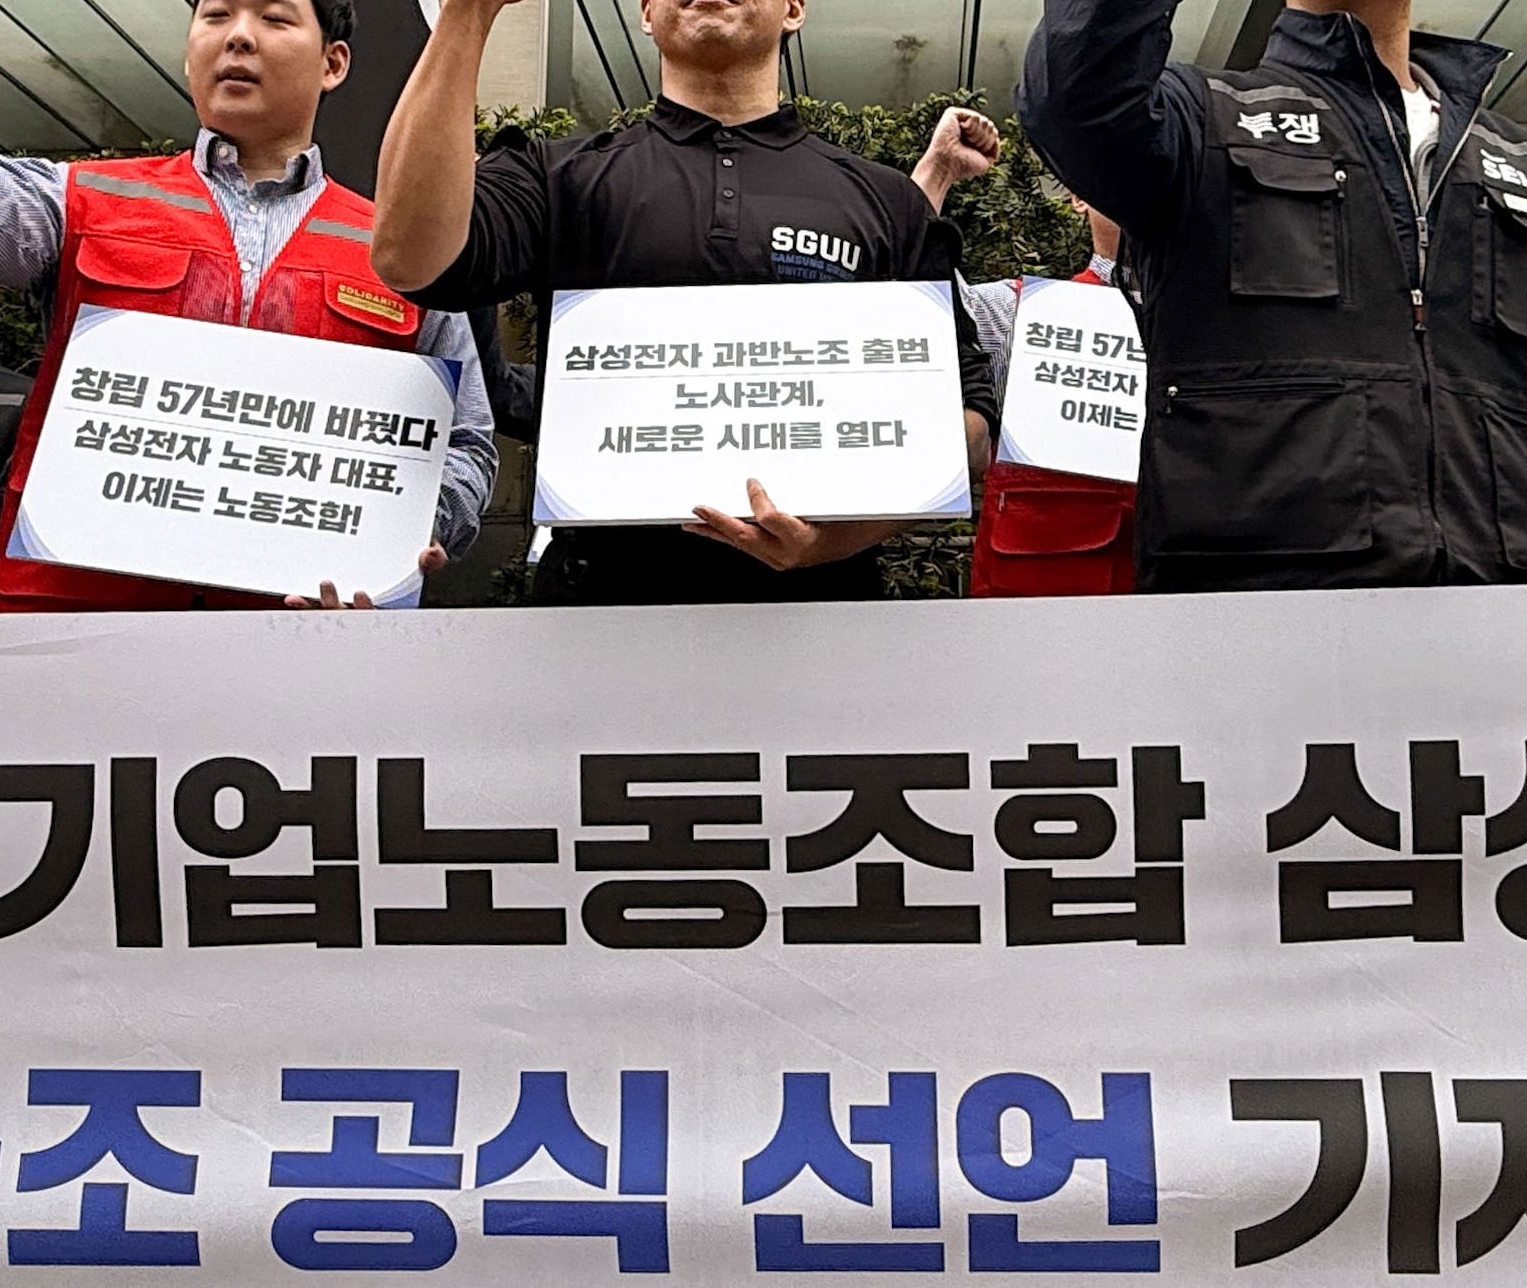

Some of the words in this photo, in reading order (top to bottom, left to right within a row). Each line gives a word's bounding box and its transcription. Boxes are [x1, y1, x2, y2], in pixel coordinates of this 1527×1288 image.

[1238, 112, 1320, 143] 투쟁
[772, 227, 860, 270] SGUU
[566, 344, 702, 371] 삼성전자
[713, 341, 849, 367] 과반노조
[863, 339, 929, 363] 출범
[1027, 323, 1082, 352] 창립
[1091, 332, 1147, 363] 57년
[676, 381, 823, 408] 노사관계,
[1035, 362, 1138, 396] 삼성전자
[72, 368, 148, 408] 창립
[158, 381, 315, 433] 57년만에
[325, 406, 438, 451] 바꿨다
[1061, 400, 1137, 431] 이제는
[599, 425, 703, 453] 새로운
[718, 423, 821, 450] 시대를
[837, 421, 906, 448] 열다
[75, 420, 211, 465] 삼성전자
[219, 441, 322, 481] 노동자
[331, 458, 403, 495] 대표,
[103, 472, 204, 512] 이제는
[214, 487, 362, 535] 노동조합!
[269, 1068, 671, 1274] 공식
[743, 1072, 1160, 1273] 선언
